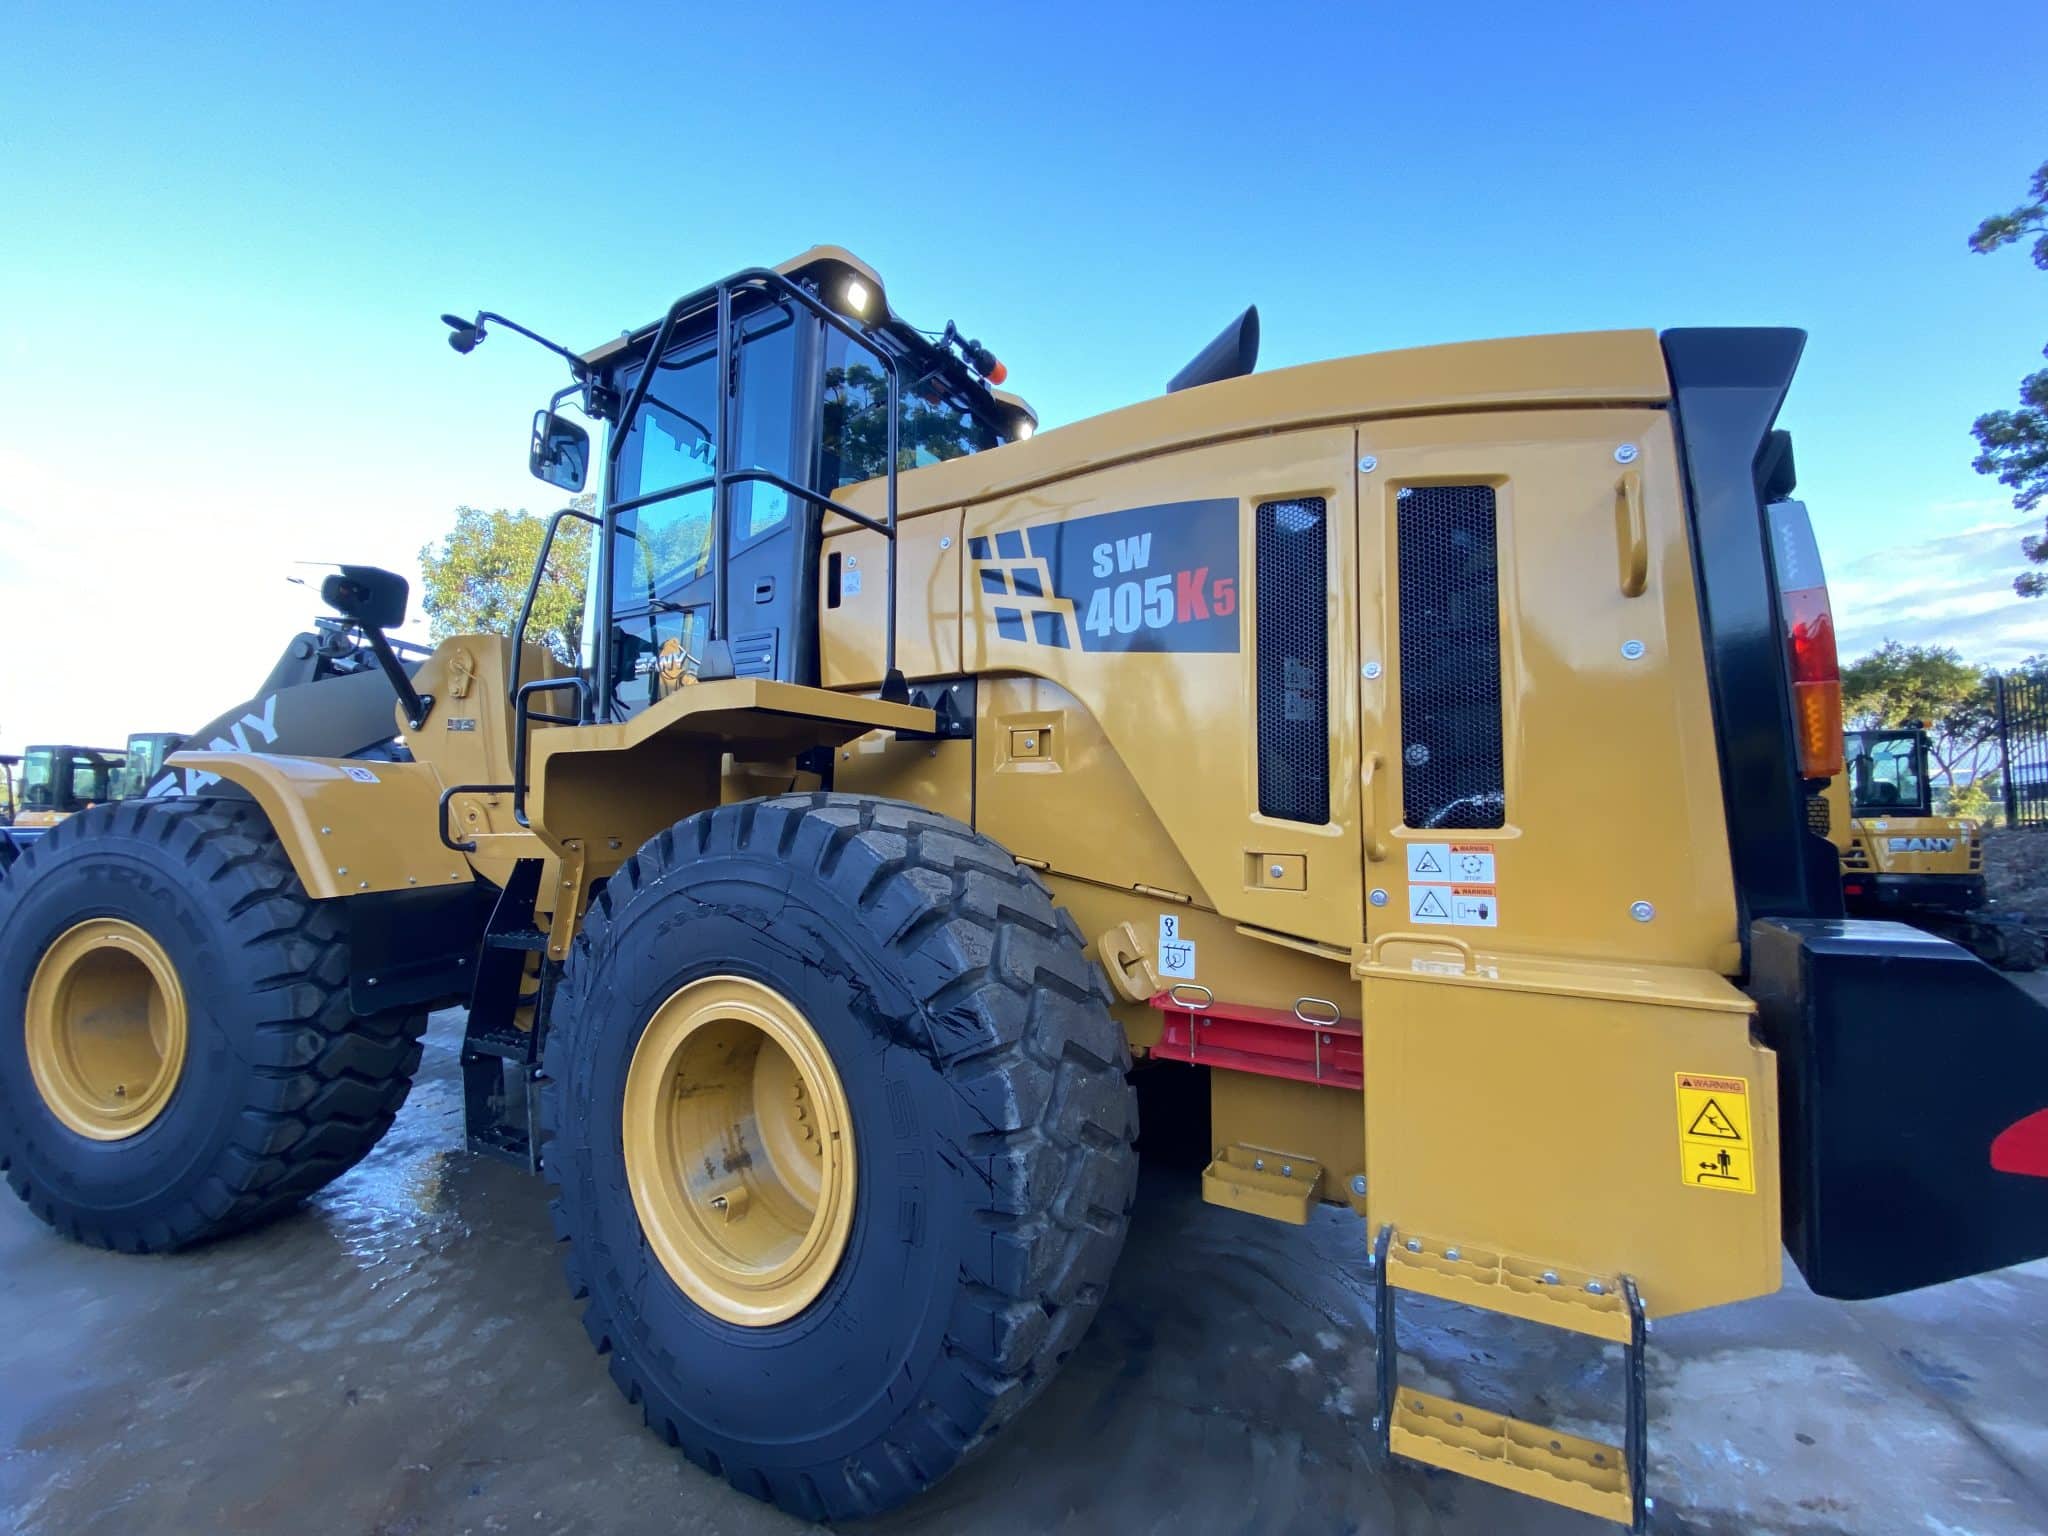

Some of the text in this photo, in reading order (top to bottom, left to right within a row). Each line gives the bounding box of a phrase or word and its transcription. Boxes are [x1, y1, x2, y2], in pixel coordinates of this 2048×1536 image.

[1092, 532, 1152, 578] SW
[1888, 838, 1956, 853] SANY
[1462, 888, 1493, 896] WARNING
[1693, 1079, 1742, 1091] WARNING
